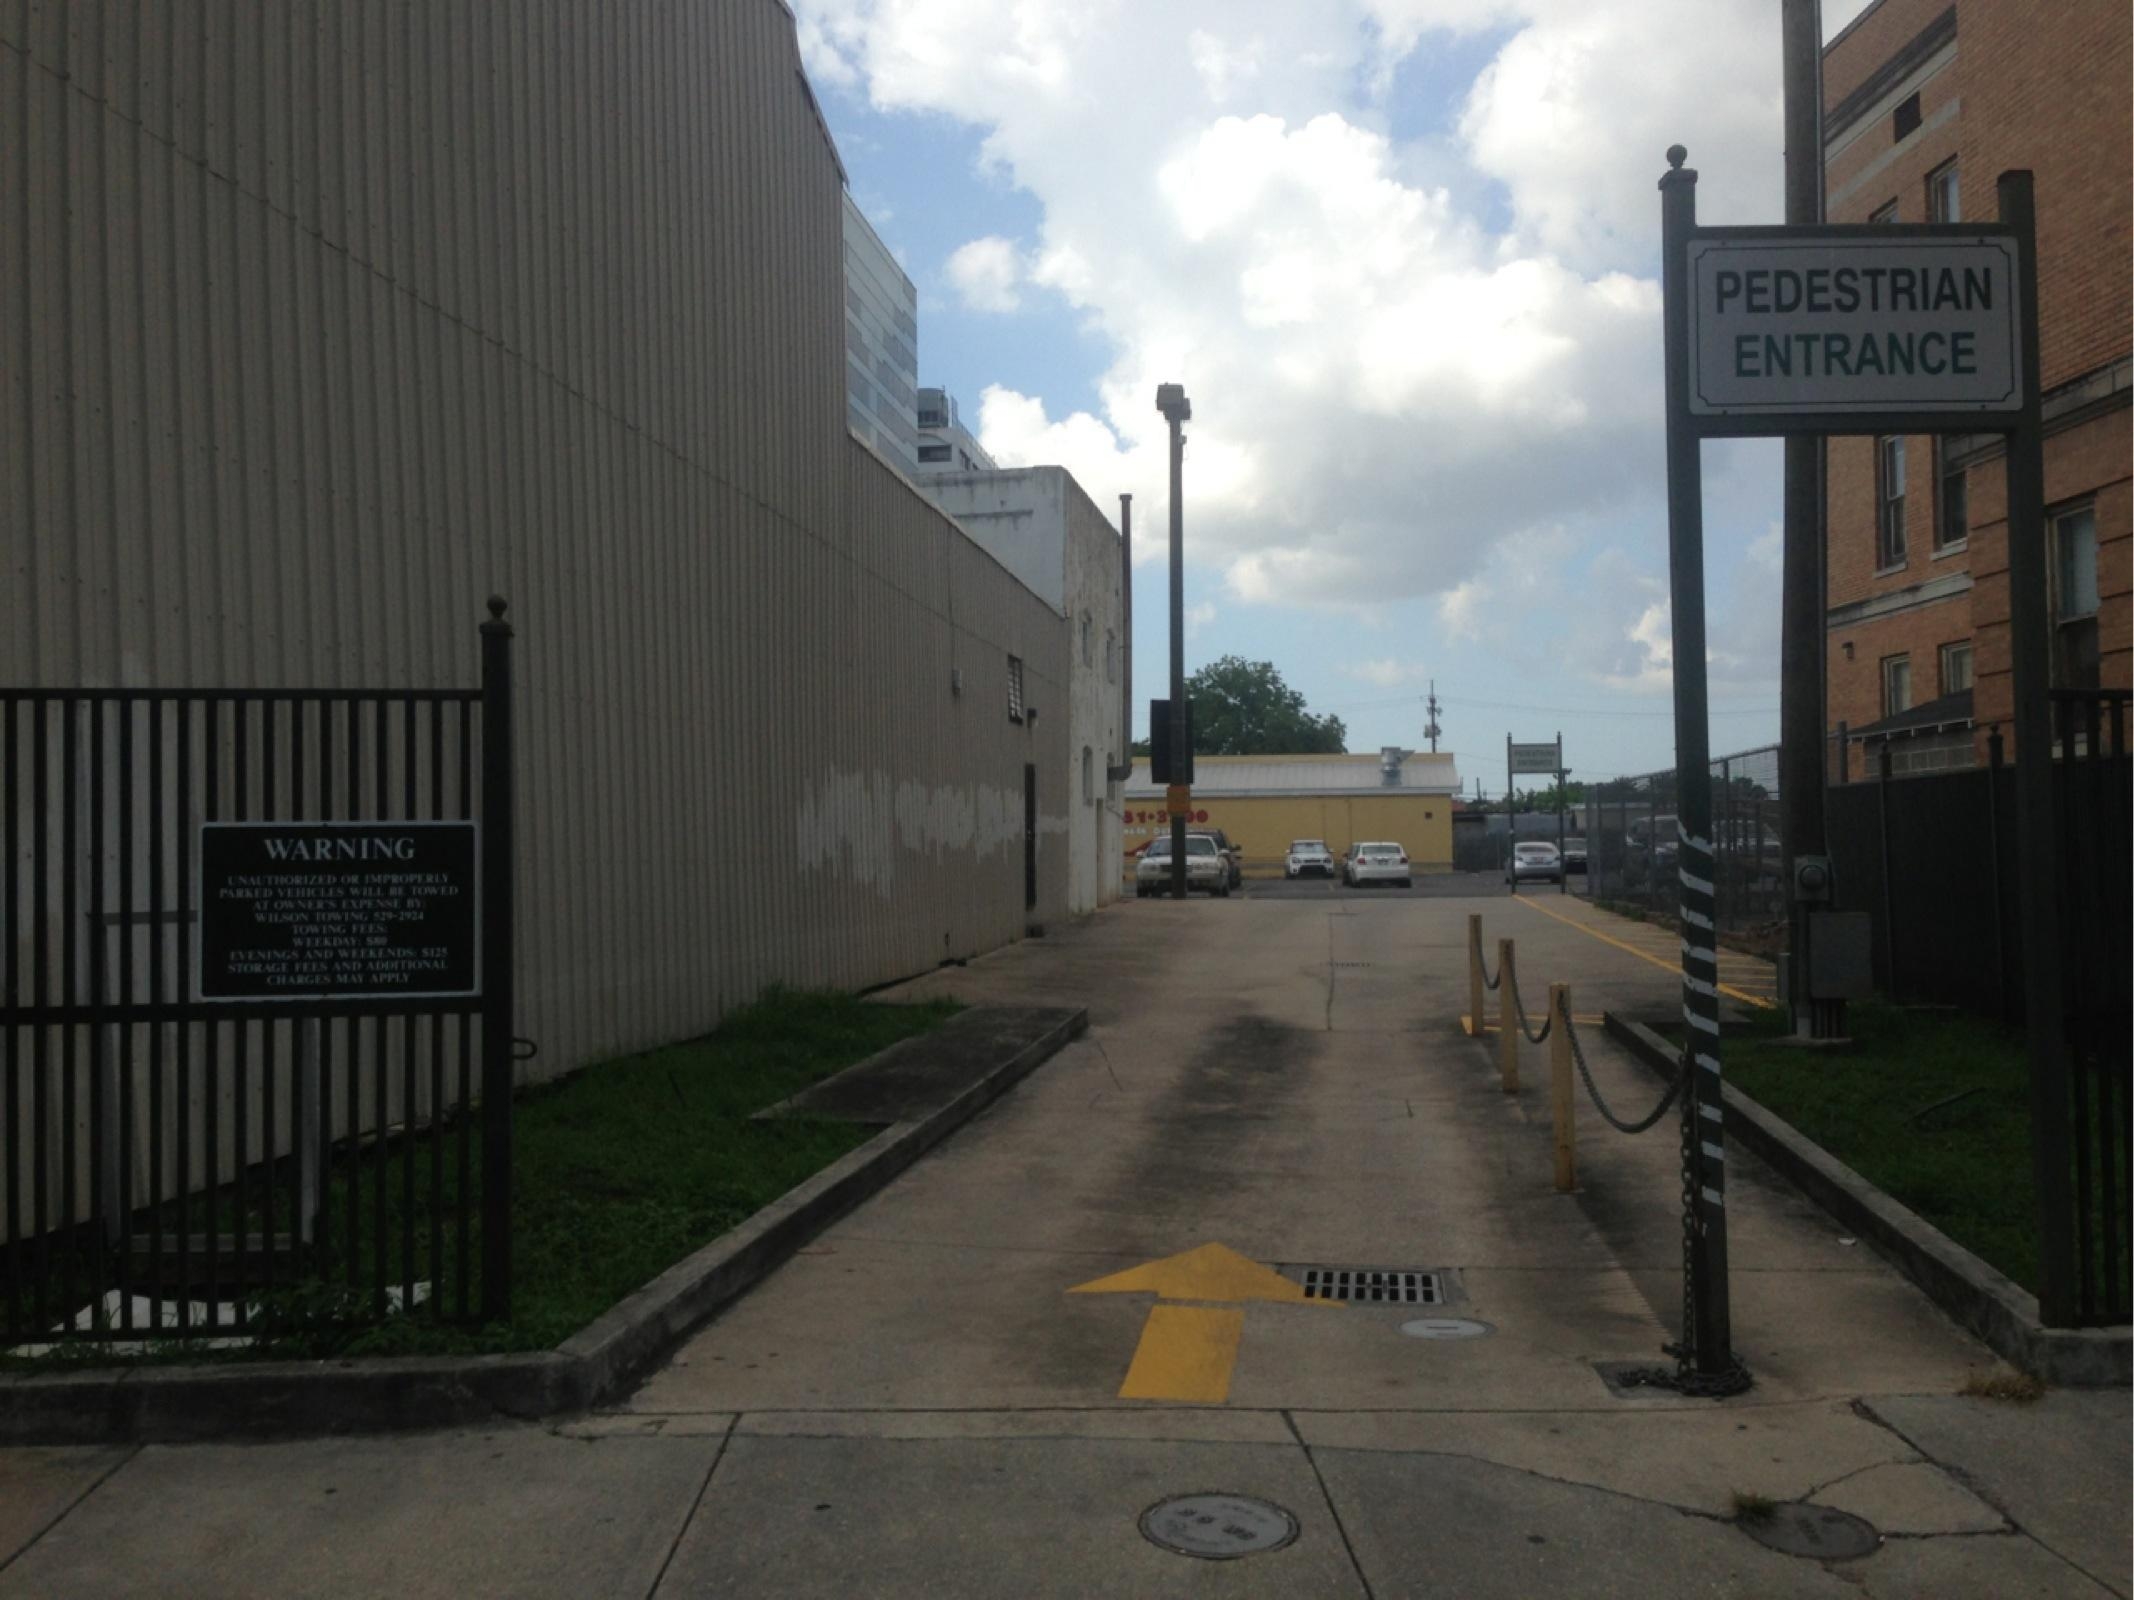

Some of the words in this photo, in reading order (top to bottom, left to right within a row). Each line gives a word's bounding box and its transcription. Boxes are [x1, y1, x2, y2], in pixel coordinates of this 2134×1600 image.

[1716, 267, 1992, 313] PEDESTRIAN
[1735, 331, 1977, 377] ENTRANCE
[264, 838, 416, 860] WARNING
[227, 874, 336, 886] UNAUTHORIZED
[341, 874, 360, 885] OR
[365, 873, 449, 884] IMPROPERLY
[219, 888, 273, 899] PARKED
[278, 887, 345, 898] VEHICLES
[349, 887, 384, 897] WILL
[389, 886, 405, 897] BE
[412, 886, 459, 896] TOWED
[254, 900, 270, 911] AT
[342, 899, 401, 909] EXPENSE
[255, 912, 309, 923] WILSON
[316, 912, 368, 922] TOWING
[293, 924, 346, 935] TOWING
[229, 949, 299, 961] EVENINGS
[304, 949, 333, 960] AND
[227, 962, 289, 974] STORAGE
[294, 962, 328, 973] FEES
[332, 961, 362, 972] AND
[366, 960, 449, 971] ADDITIONAL
[266, 975, 331, 986] CHARGES
[335, 974, 364, 984] MAY
[369, 973, 411, 984] APPLY
